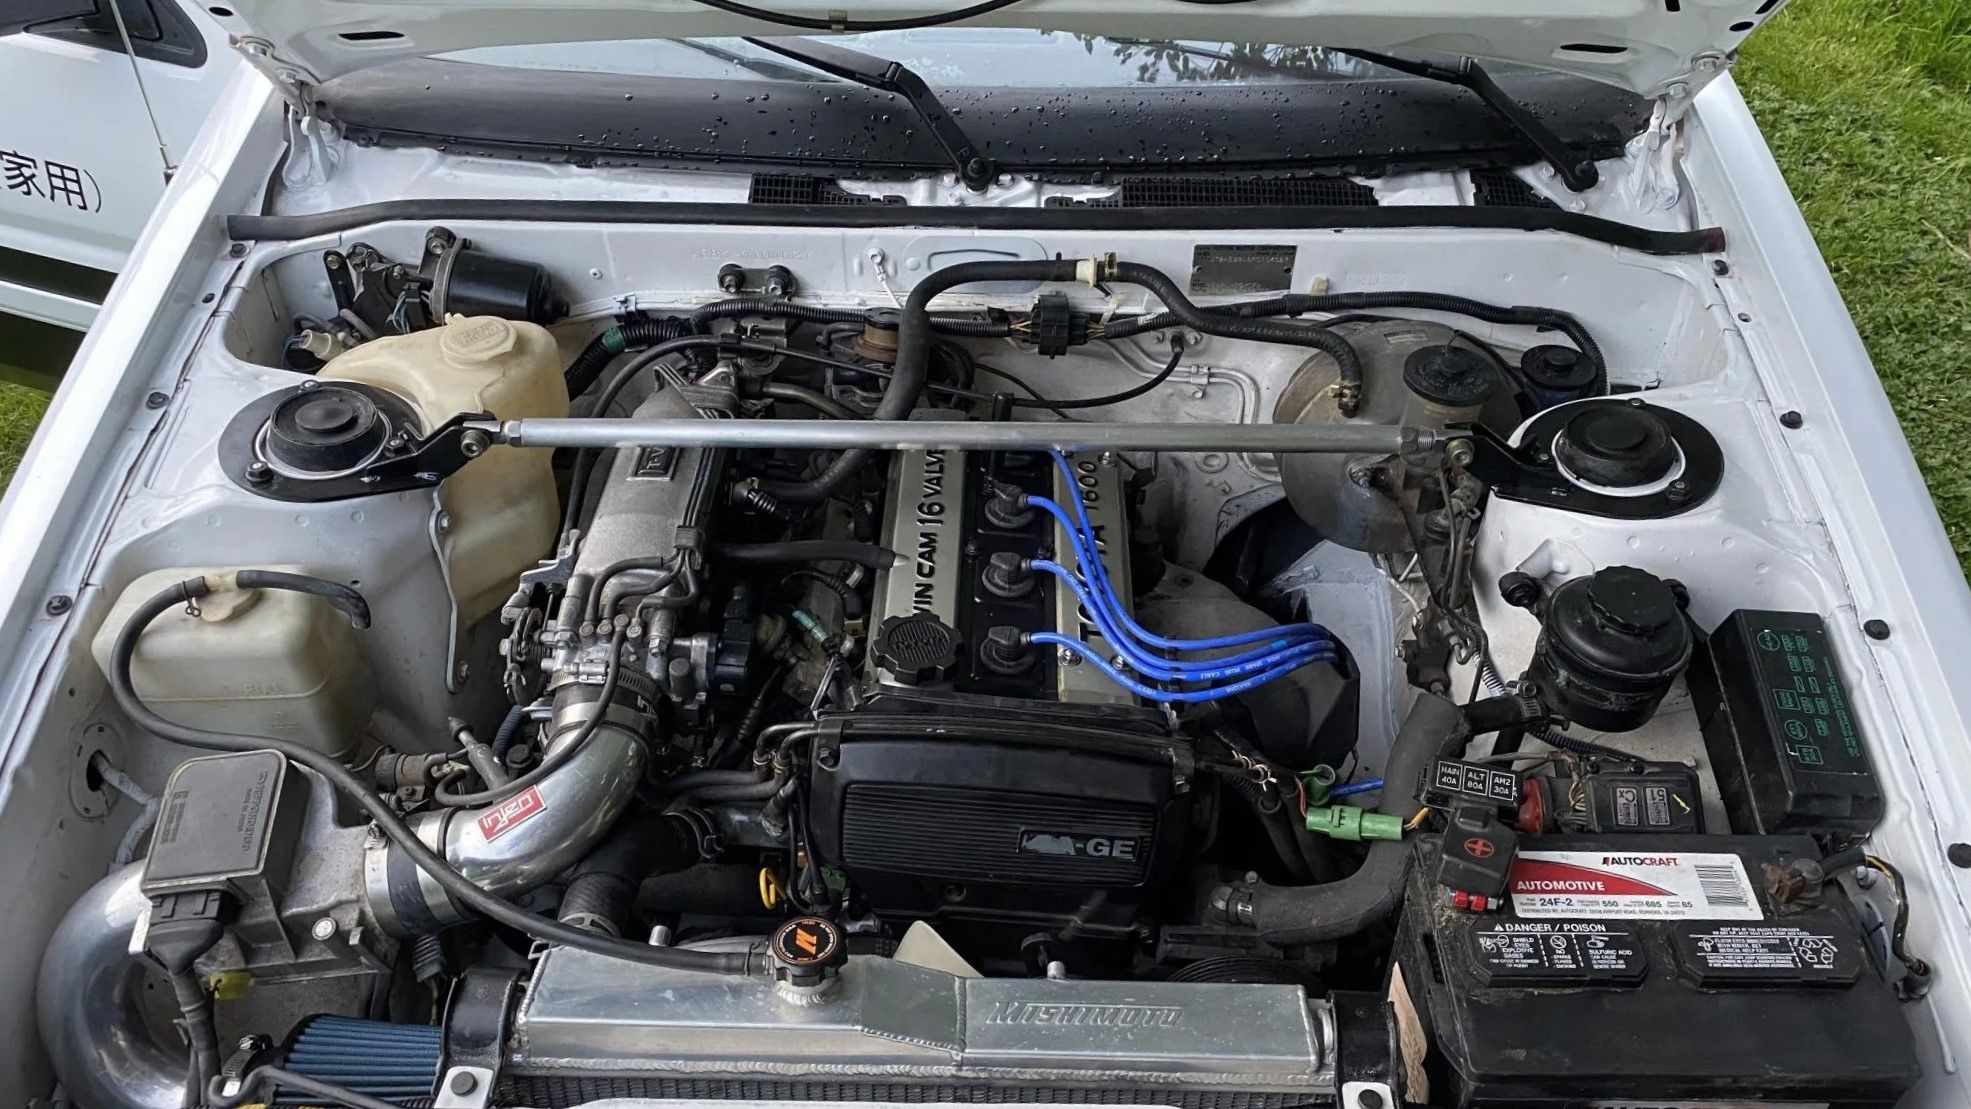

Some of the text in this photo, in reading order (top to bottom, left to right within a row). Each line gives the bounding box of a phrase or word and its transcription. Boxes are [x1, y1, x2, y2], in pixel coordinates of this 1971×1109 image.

[916, 501, 945, 526] 16
[916, 532, 938, 579] CAM
[1467, 771, 1485, 780] ALT
[1441, 776, 1457, 785] 40A
[1493, 776, 1511, 786] AM2
[1493, 786, 1509, 795] 30A
[1610, 856, 1679, 867] AUTOCRAFT
[1517, 880, 1606, 891] AUTOMOTIVE
[1540, 898, 1574, 907] 24F-2
[1602, 900, 1619, 908] 550
[1505, 923, 1551, 932] DANGER
[1563, 924, 1606, 932] POISON
[986, 1002, 1183, 1027] MISHIMOTO
